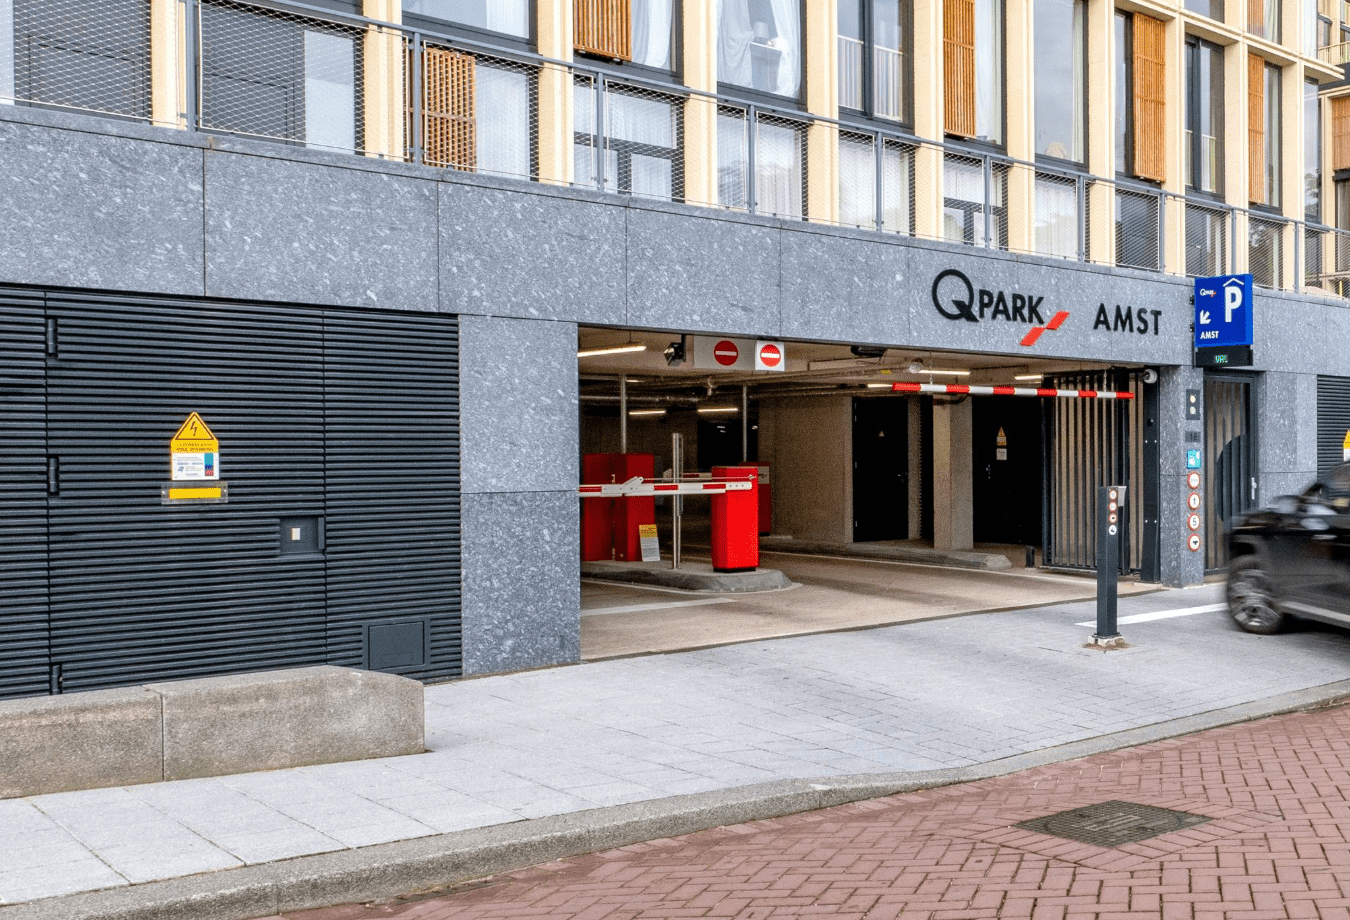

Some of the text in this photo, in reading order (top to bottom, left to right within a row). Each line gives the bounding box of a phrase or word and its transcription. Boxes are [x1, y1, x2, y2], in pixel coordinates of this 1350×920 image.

[1093, 302, 1163, 335] AMST
[1224, 286, 1243, 323] P
[1200, 331, 1219, 339] AMST
